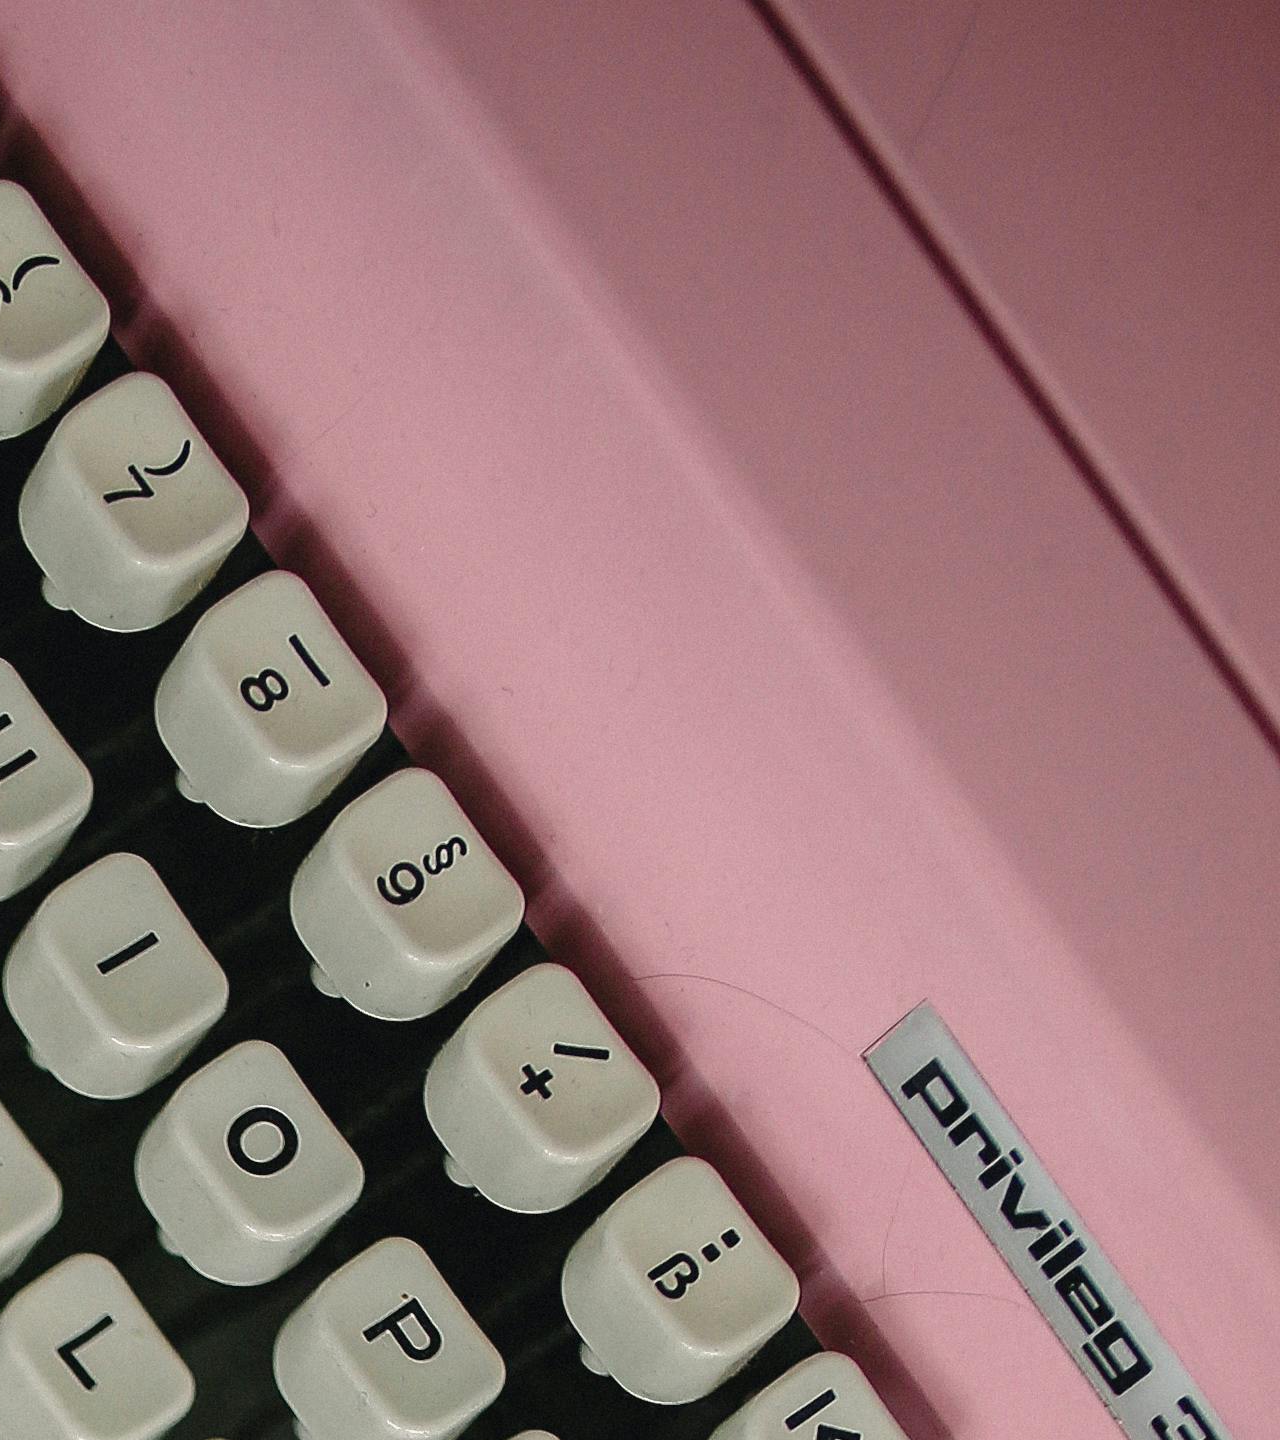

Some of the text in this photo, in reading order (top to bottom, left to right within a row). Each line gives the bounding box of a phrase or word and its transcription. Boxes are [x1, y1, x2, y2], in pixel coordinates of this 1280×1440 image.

[103, 465, 154, 504] 7
[240, 668, 289, 712] 8
[376, 862, 425, 906] 9
[97, 932, 159, 975] I
[226, 1107, 299, 1176] O
[900, 1058, 1152, 1396] privileg
[56, 1315, 114, 1391] L
[363, 1298, 442, 1361] P
